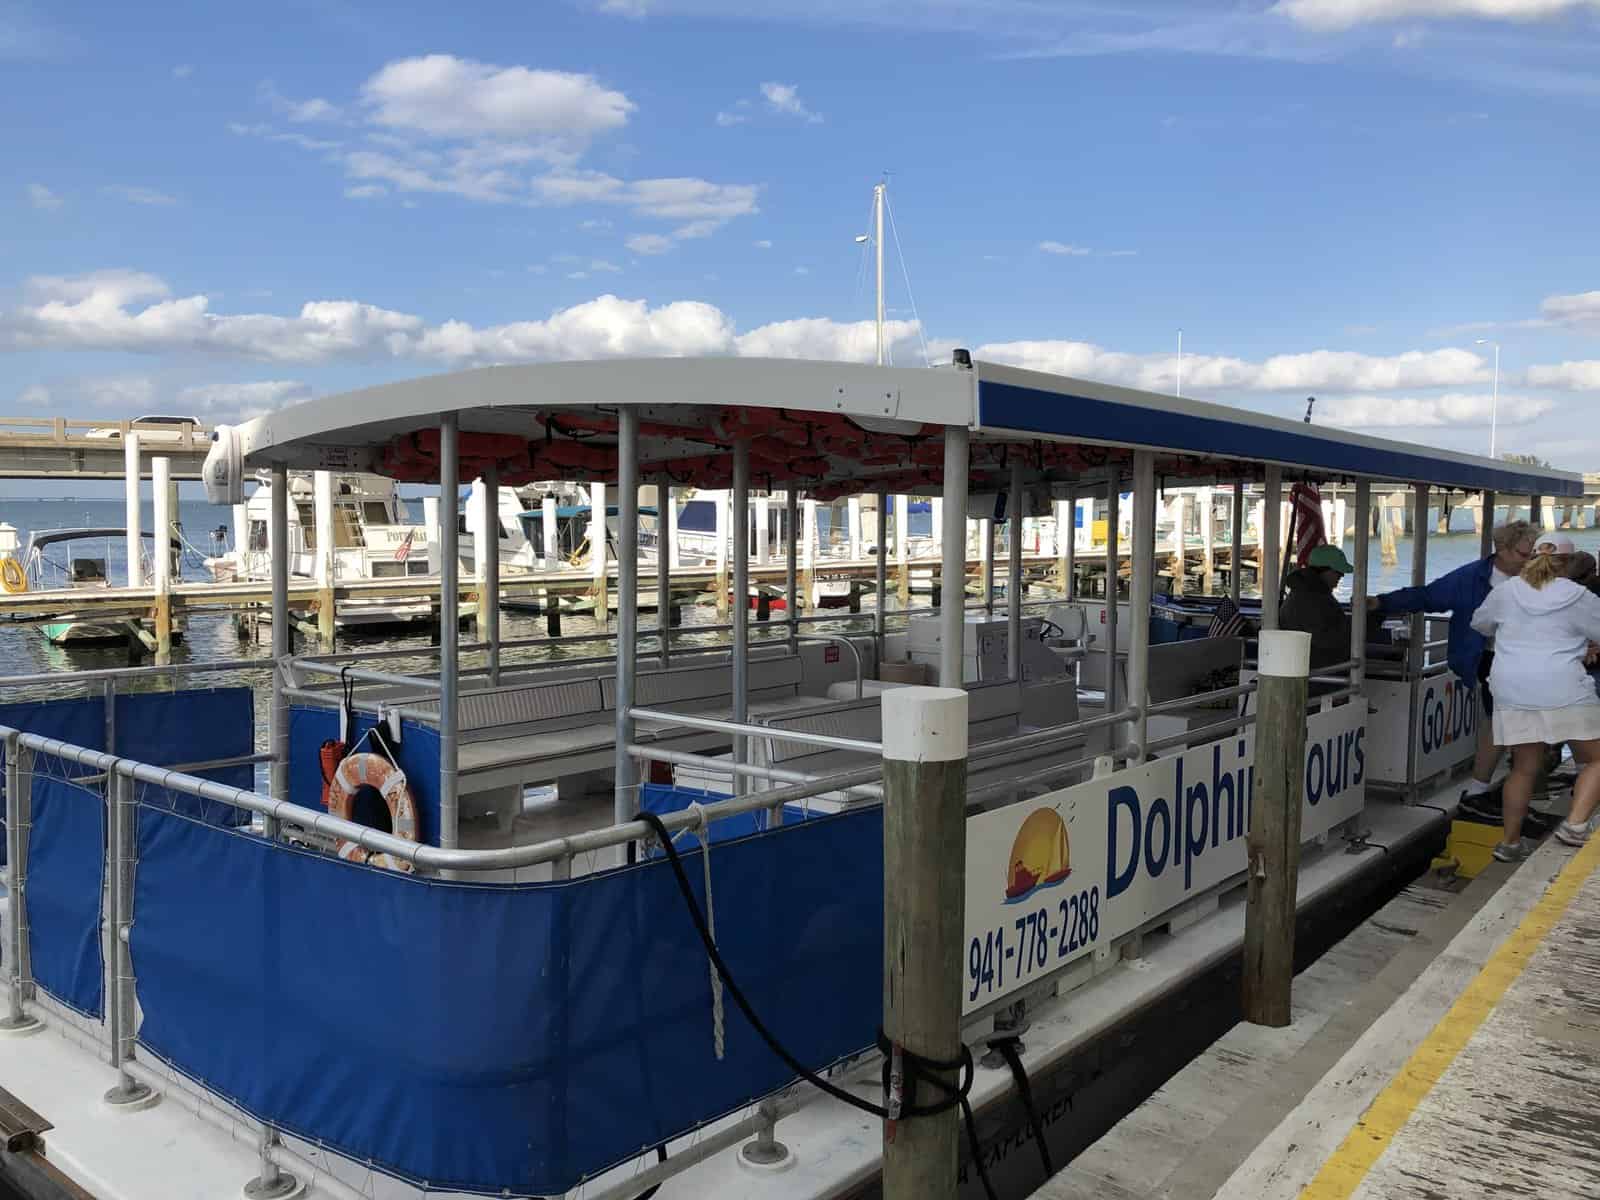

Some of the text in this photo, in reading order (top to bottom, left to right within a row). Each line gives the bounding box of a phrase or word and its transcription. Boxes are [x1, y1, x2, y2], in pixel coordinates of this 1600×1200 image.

[1422, 679, 1479, 754] Go2Dol
[1306, 726, 1365, 806] ours
[969, 885, 1099, 1001] 941-778-2288
